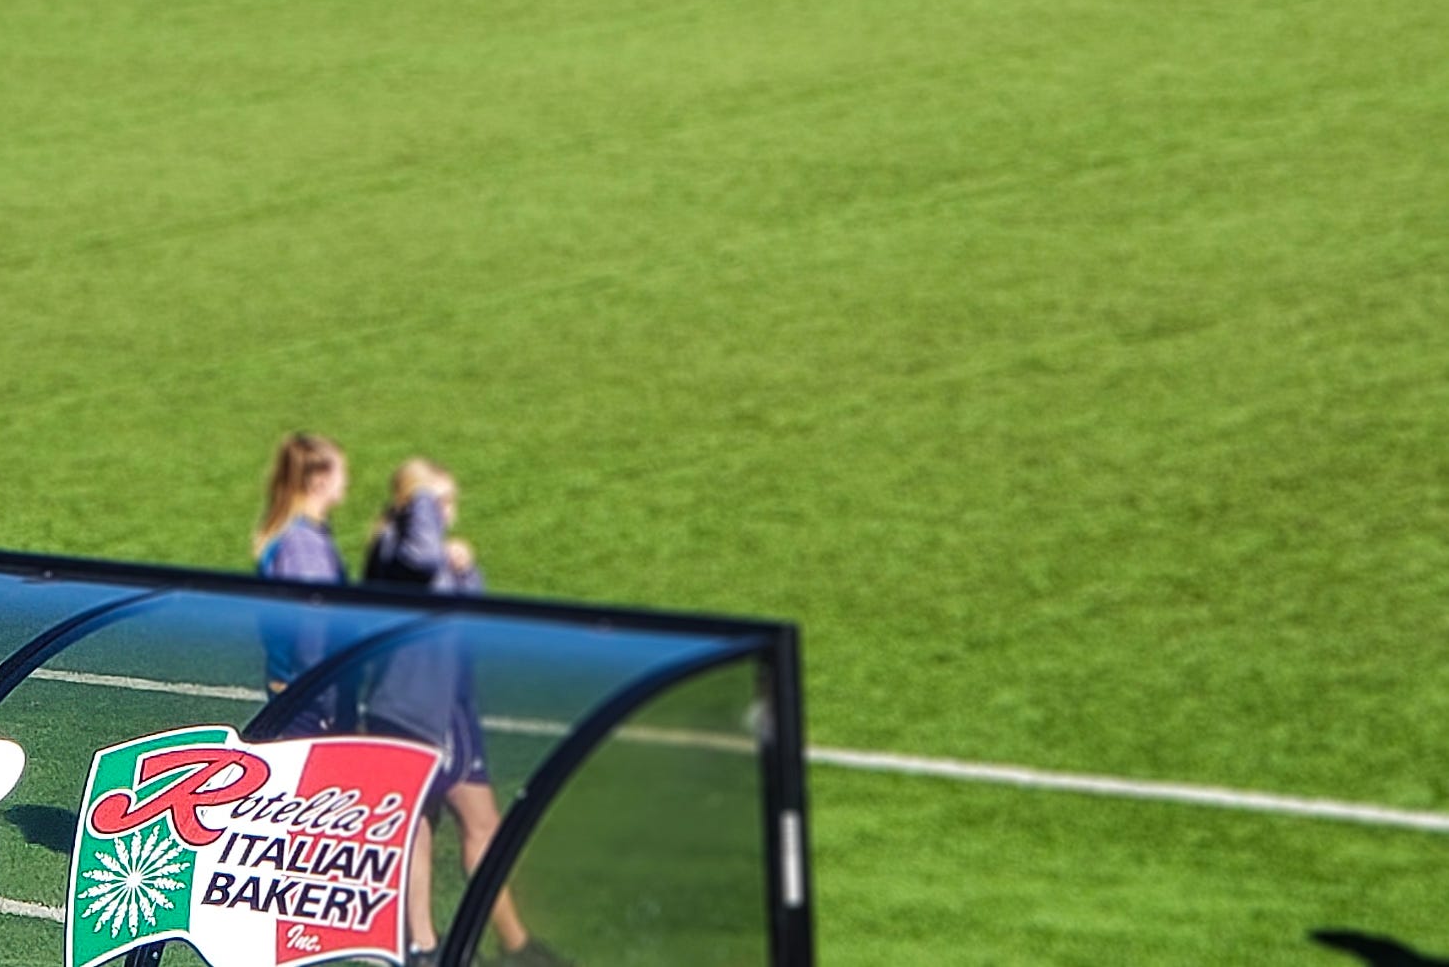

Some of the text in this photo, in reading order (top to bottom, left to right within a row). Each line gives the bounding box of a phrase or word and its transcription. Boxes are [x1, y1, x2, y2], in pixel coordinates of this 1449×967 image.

[91, 748, 403, 846] Rotella's
[217, 832, 396, 883] ITALIAN
[201, 871, 390, 926] BAKERY
[286, 925, 321, 952] Inc.
